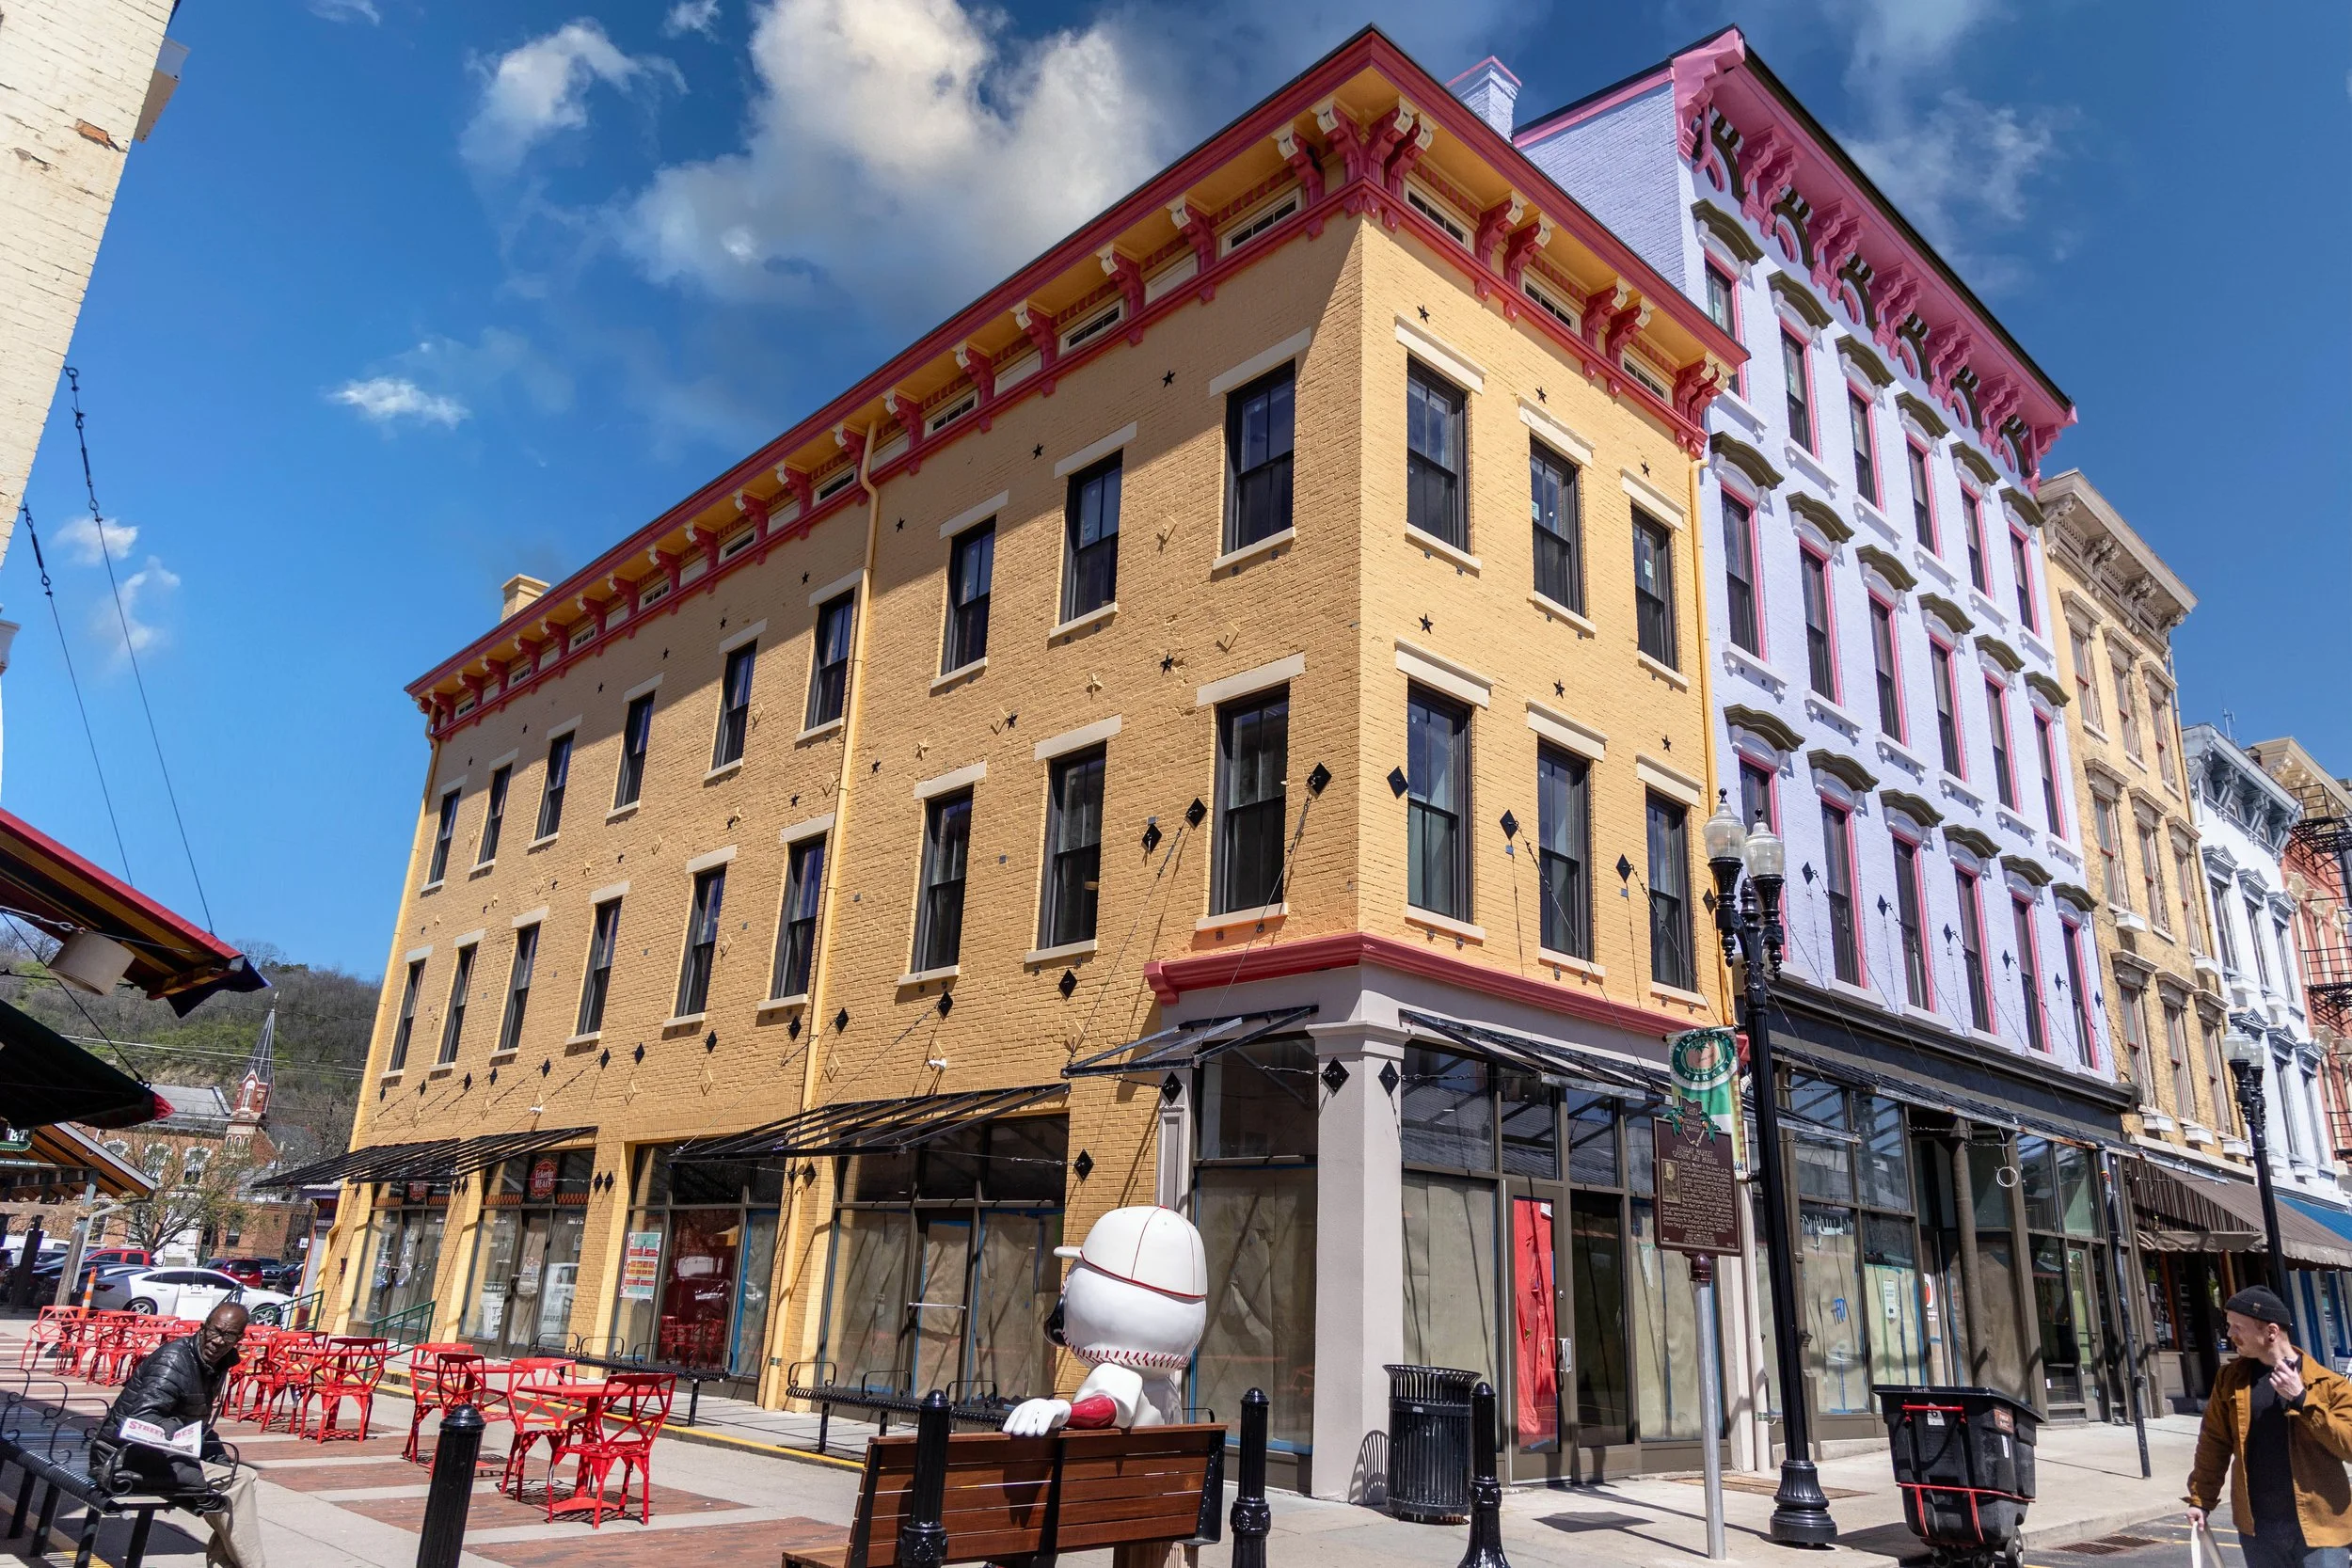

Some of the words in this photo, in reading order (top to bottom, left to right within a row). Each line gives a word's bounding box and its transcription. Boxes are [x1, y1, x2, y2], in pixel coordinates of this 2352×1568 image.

[1676, 1030, 1727, 1053] FINDLAY
[1683, 1059, 1730, 1082] MARKET
[535, 1169, 553, 1178] Eckerlin
[535, 1179, 551, 1188] MEATS
